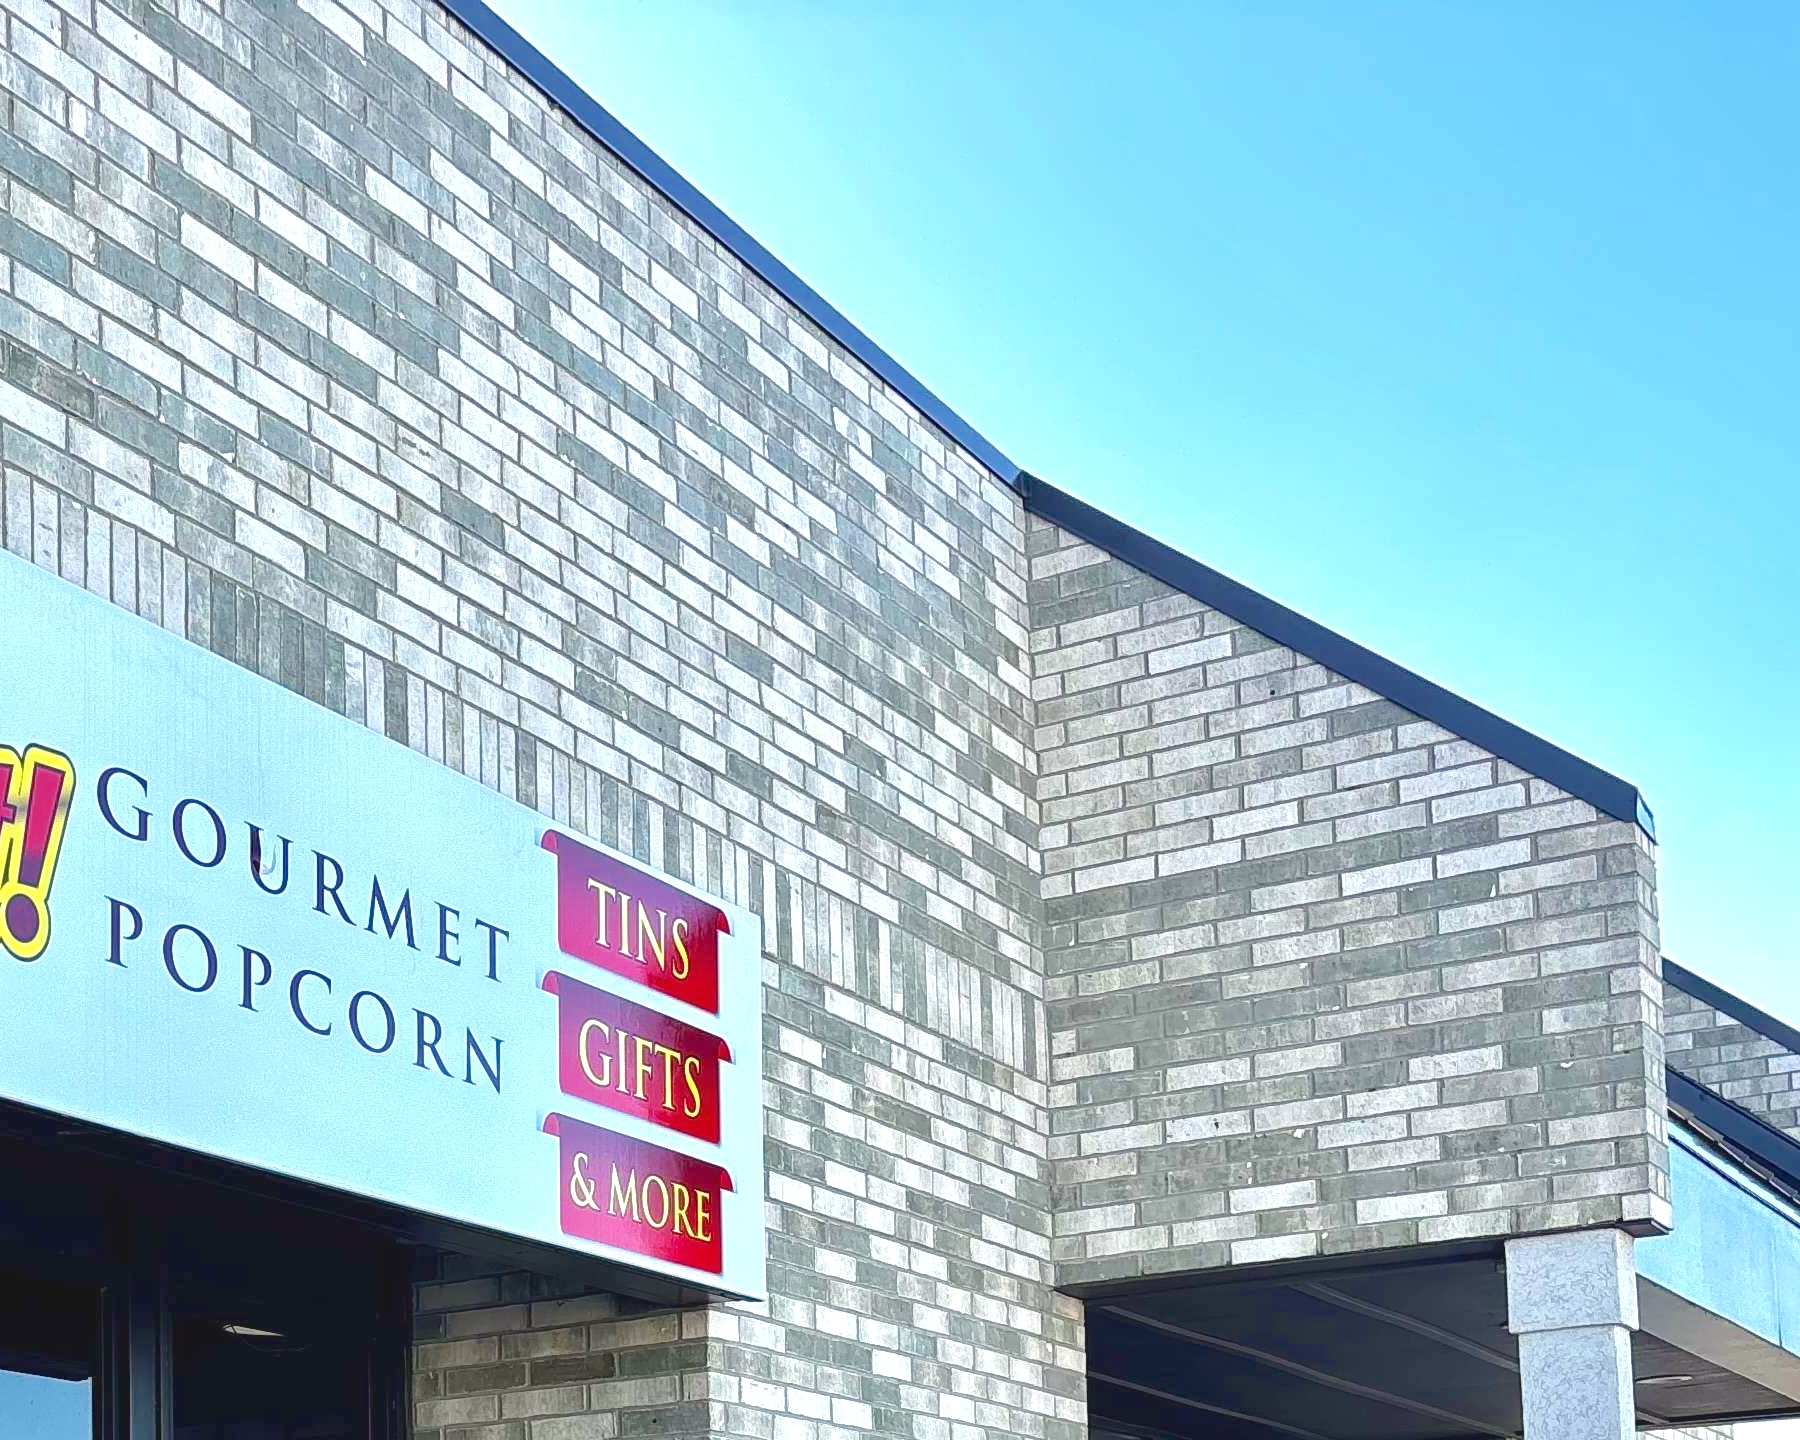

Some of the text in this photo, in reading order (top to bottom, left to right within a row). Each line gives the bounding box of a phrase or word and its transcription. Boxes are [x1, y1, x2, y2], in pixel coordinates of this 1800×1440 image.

[97, 767, 510, 983] GOURMET
[586, 877, 690, 980] TINS
[104, 895, 505, 1095] POPCORN
[578, 1018, 702, 1119] GIFTS
[570, 1151, 713, 1243] & MORE
